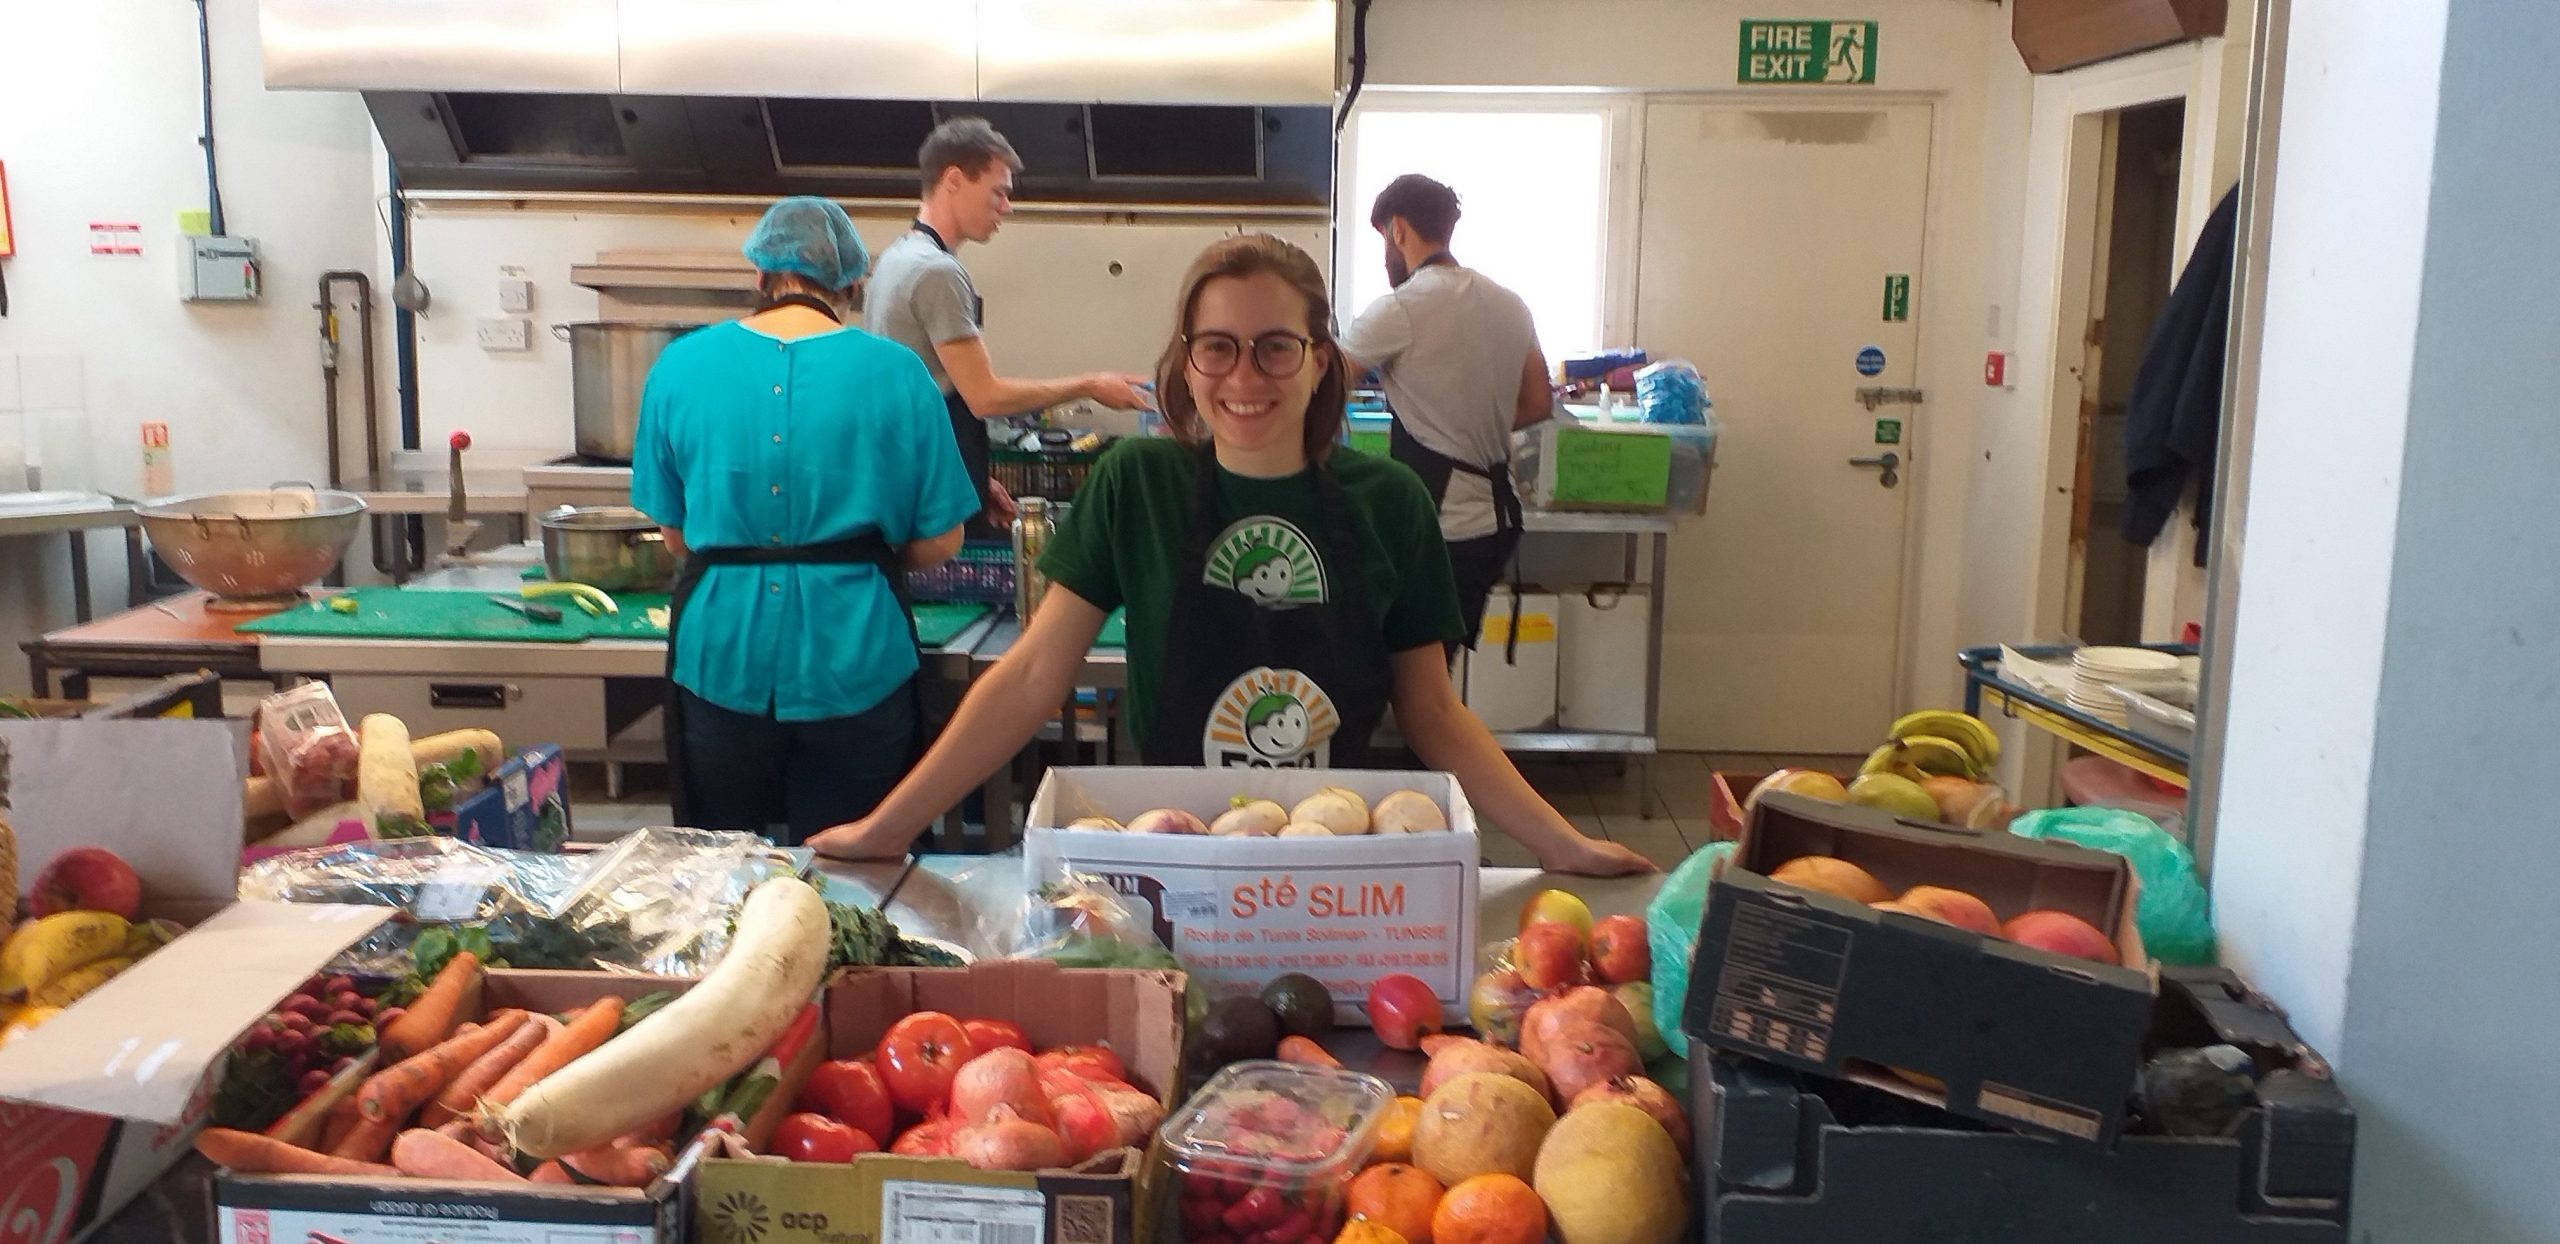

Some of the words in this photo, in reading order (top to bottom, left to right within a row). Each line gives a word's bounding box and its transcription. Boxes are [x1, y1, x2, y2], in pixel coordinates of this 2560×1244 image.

[1751, 25, 1812, 50] FIRE
[1750, 54, 1812, 79] EXIT
[1231, 871, 1298, 919] Sté
[1308, 882, 1406, 918] SLIM
[1183, 926, 1231, 944] Route
[1234, 927, 1255, 944] de
[1260, 927, 1301, 943] Tunis
[780, 1212, 828, 1234] acp
